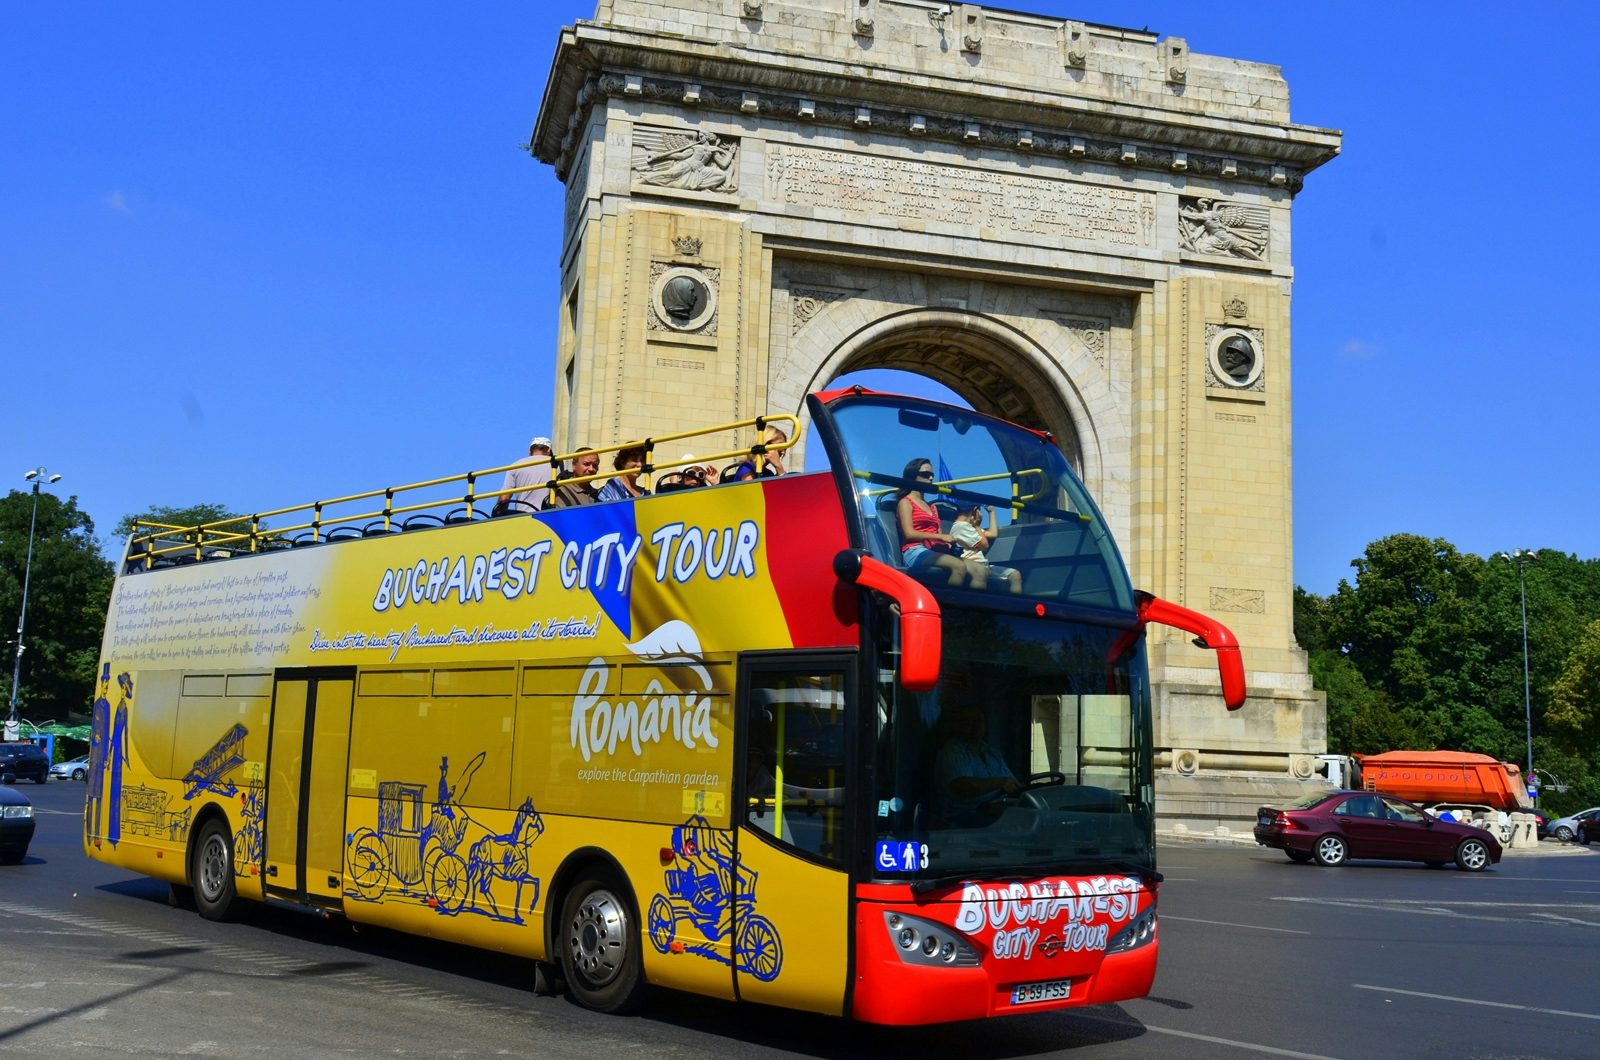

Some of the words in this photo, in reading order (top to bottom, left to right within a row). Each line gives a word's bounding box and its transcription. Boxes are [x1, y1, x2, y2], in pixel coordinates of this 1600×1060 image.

[820, 152, 856, 165] SECOLE
[863, 156, 876, 168] DE
[785, 194, 798, 204] CU
[786, 170, 798, 180] DE
[867, 181, 875, 190] A
[992, 196, 1004, 207] SE
[372, 540, 552, 612] BUCHAREST
[560, 531, 642, 596] CITY
[650, 520, 759, 584] TOUR
[310, 629, 330, 651] Dive
[332, 632, 355, 649] into
[351, 631, 366, 648] the
[367, 632, 396, 648] heart
[389, 631, 405, 662] of
[405, 624, 462, 648] Bucharest
[456, 627, 479, 644] and
[477, 624, 518, 643] discover
[521, 620, 541, 640] all
[540, 618, 558, 638] its
[558, 612, 601, 638] stories!
[570, 656, 719, 762] România
[578, 767, 610, 784] explore
[612, 768, 626, 782] the
[628, 768, 680, 786] Carpathian
[682, 771, 719, 788] garden
[920, 844, 929, 868] 3
[954, 876, 1144, 935] BUCHAREST
[993, 926, 1040, 960] CITY
[1063, 918, 1109, 952] TOUR
[1018, 986, 1026, 1001] B
[1030, 984, 1042, 1000] 59
[1045, 982, 1067, 998] FSS
